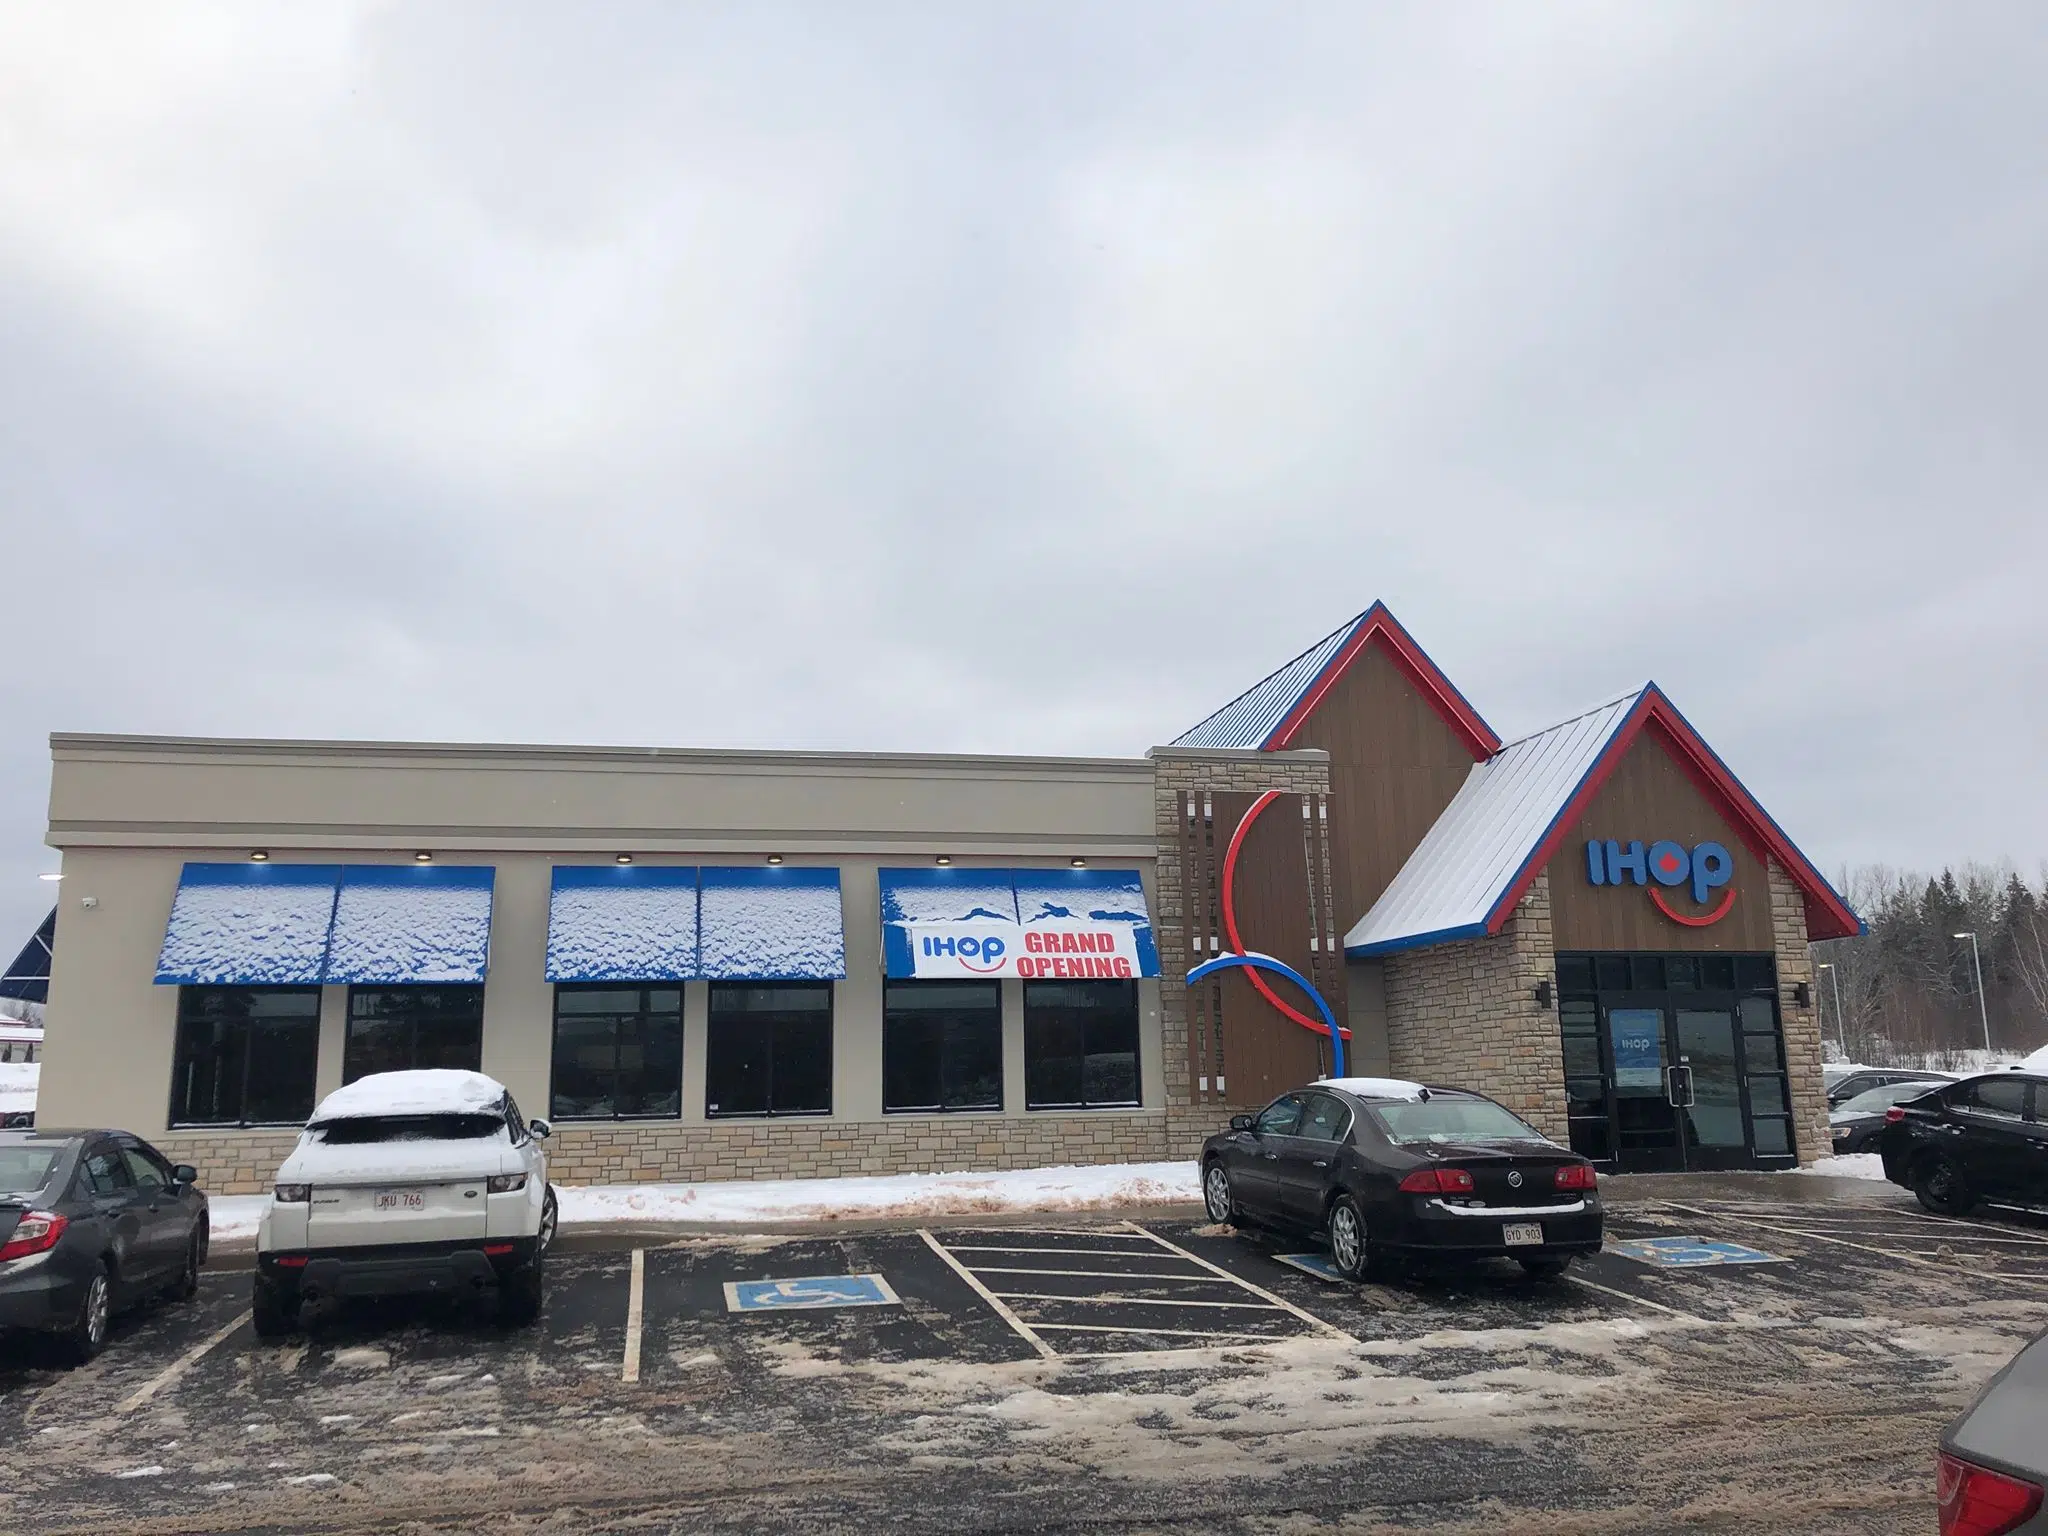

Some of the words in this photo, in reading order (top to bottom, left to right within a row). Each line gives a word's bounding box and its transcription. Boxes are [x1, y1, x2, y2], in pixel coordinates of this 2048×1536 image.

[1024, 932, 1116, 954] GRAND
[1016, 956, 1132, 977] OPENING
[378, 1195, 397, 1207] JKU
[403, 1194, 421, 1206] 766
[1525, 1228, 1541, 1240] 903
